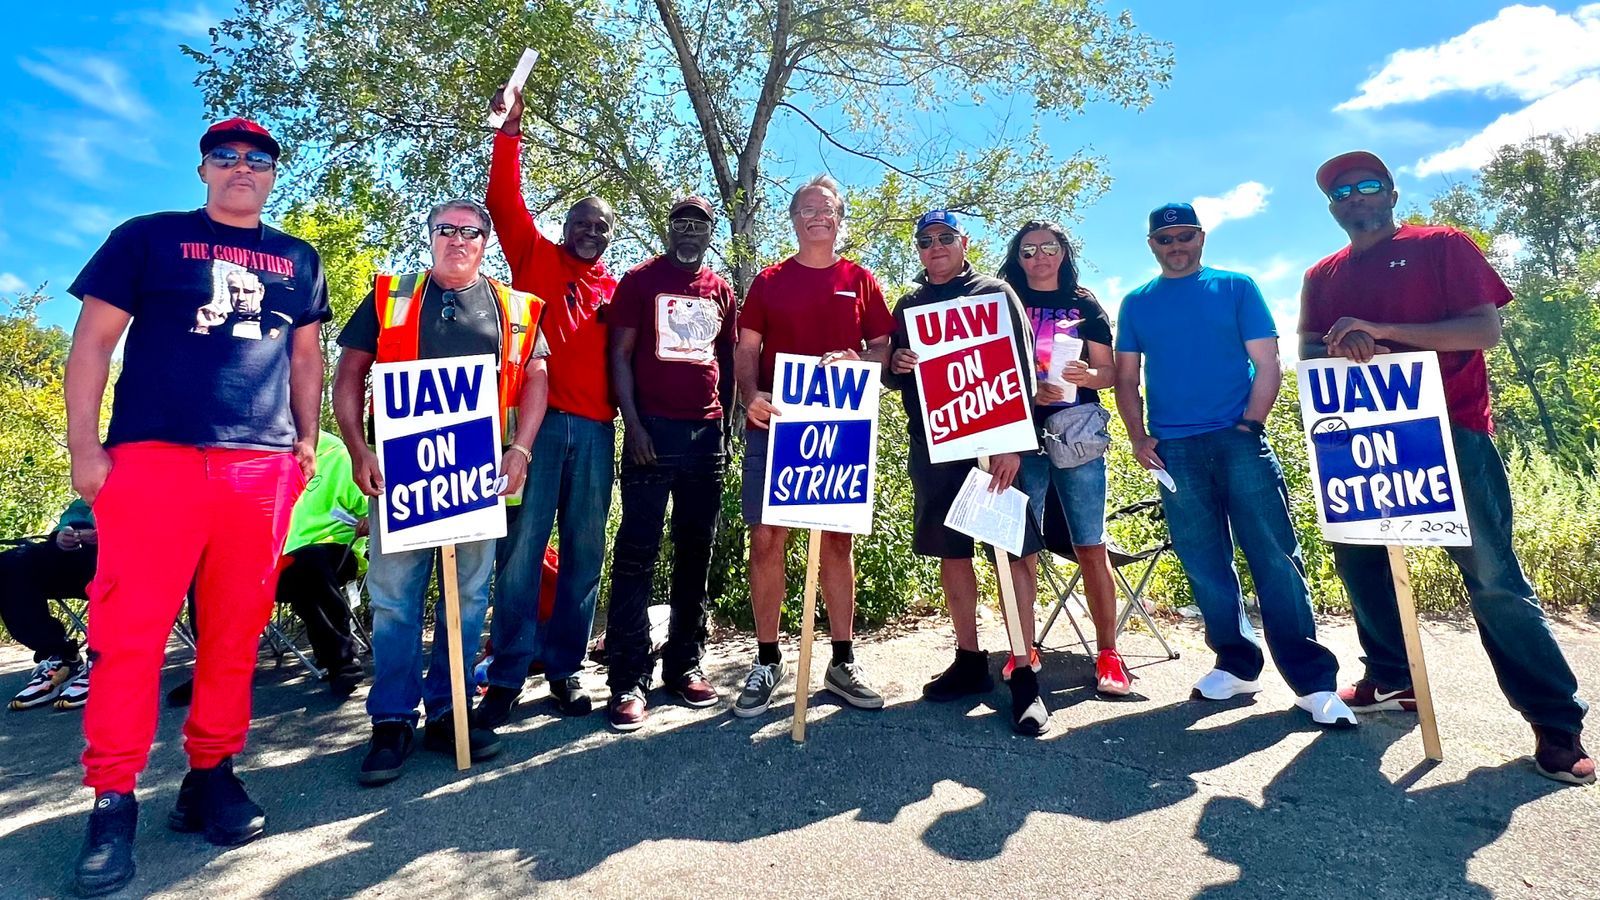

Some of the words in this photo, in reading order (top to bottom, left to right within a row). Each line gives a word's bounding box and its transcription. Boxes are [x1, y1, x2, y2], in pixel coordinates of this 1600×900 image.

[180, 242, 210, 260] THE
[213, 244, 295, 278] GODFATHER
[915, 302, 998, 346] UAW
[384, 364, 484, 419] UAW
[782, 362, 870, 411] UAW
[947, 349, 984, 392] ON
[1307, 361, 1423, 414] UAW
[929, 368, 1021, 441] STRIKE
[416, 431, 456, 472] ON
[800, 424, 839, 460] ON
[1351, 430, 1398, 469] ON
[391, 462, 495, 521] STRIKE
[773, 464, 867, 502] STRIKE
[1326, 465, 1450, 514] STRIKE
[1420, 520, 1468, 538] 2024
